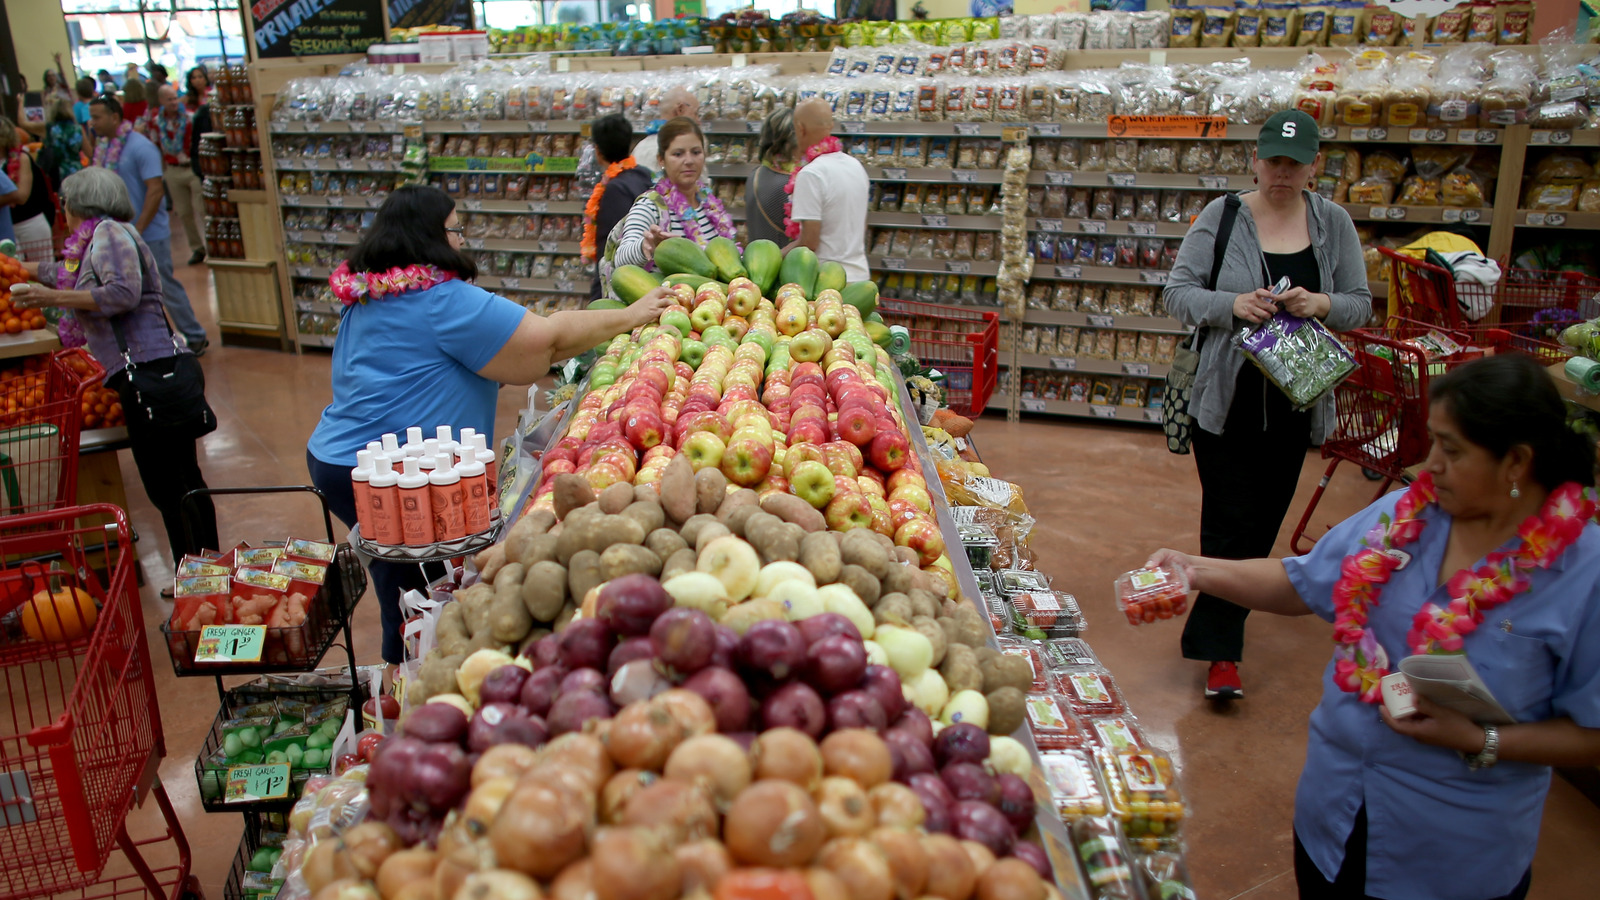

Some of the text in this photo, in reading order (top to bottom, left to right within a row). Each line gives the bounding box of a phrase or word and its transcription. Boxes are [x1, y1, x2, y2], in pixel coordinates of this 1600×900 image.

[289, 38, 351, 54] SERIOUS
[1281, 121, 1297, 138] S
[206, 628, 256, 637] FRESH GINGER
[233, 767, 276, 779] FRESH GARLIC
